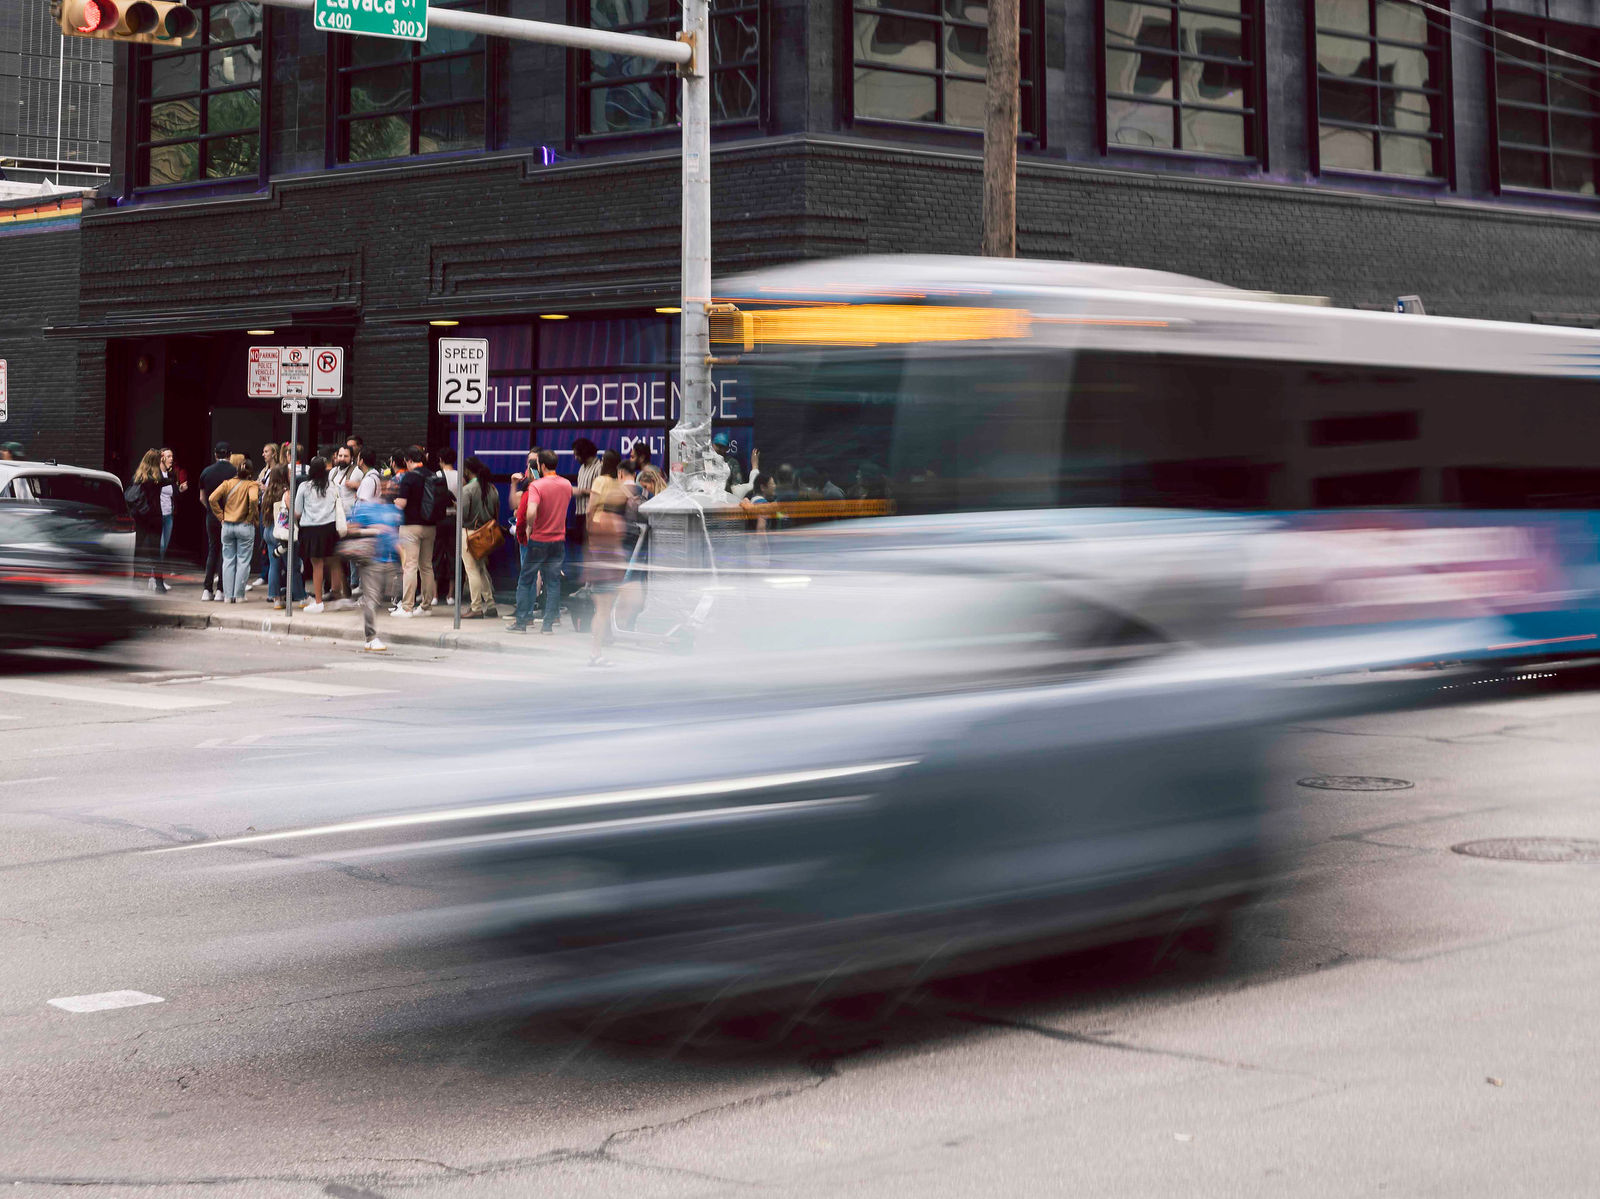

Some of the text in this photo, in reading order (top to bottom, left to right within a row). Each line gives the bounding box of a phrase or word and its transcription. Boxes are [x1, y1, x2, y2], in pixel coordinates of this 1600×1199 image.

[327, 11, 415, 36] 400 300
[250, 350, 278, 361] NO PARKING
[445, 348, 485, 360] SPEED
[448, 363, 480, 375] LIMIT
[444, 379, 482, 404] 25
[542, 379, 738, 423] EXPERIENE
